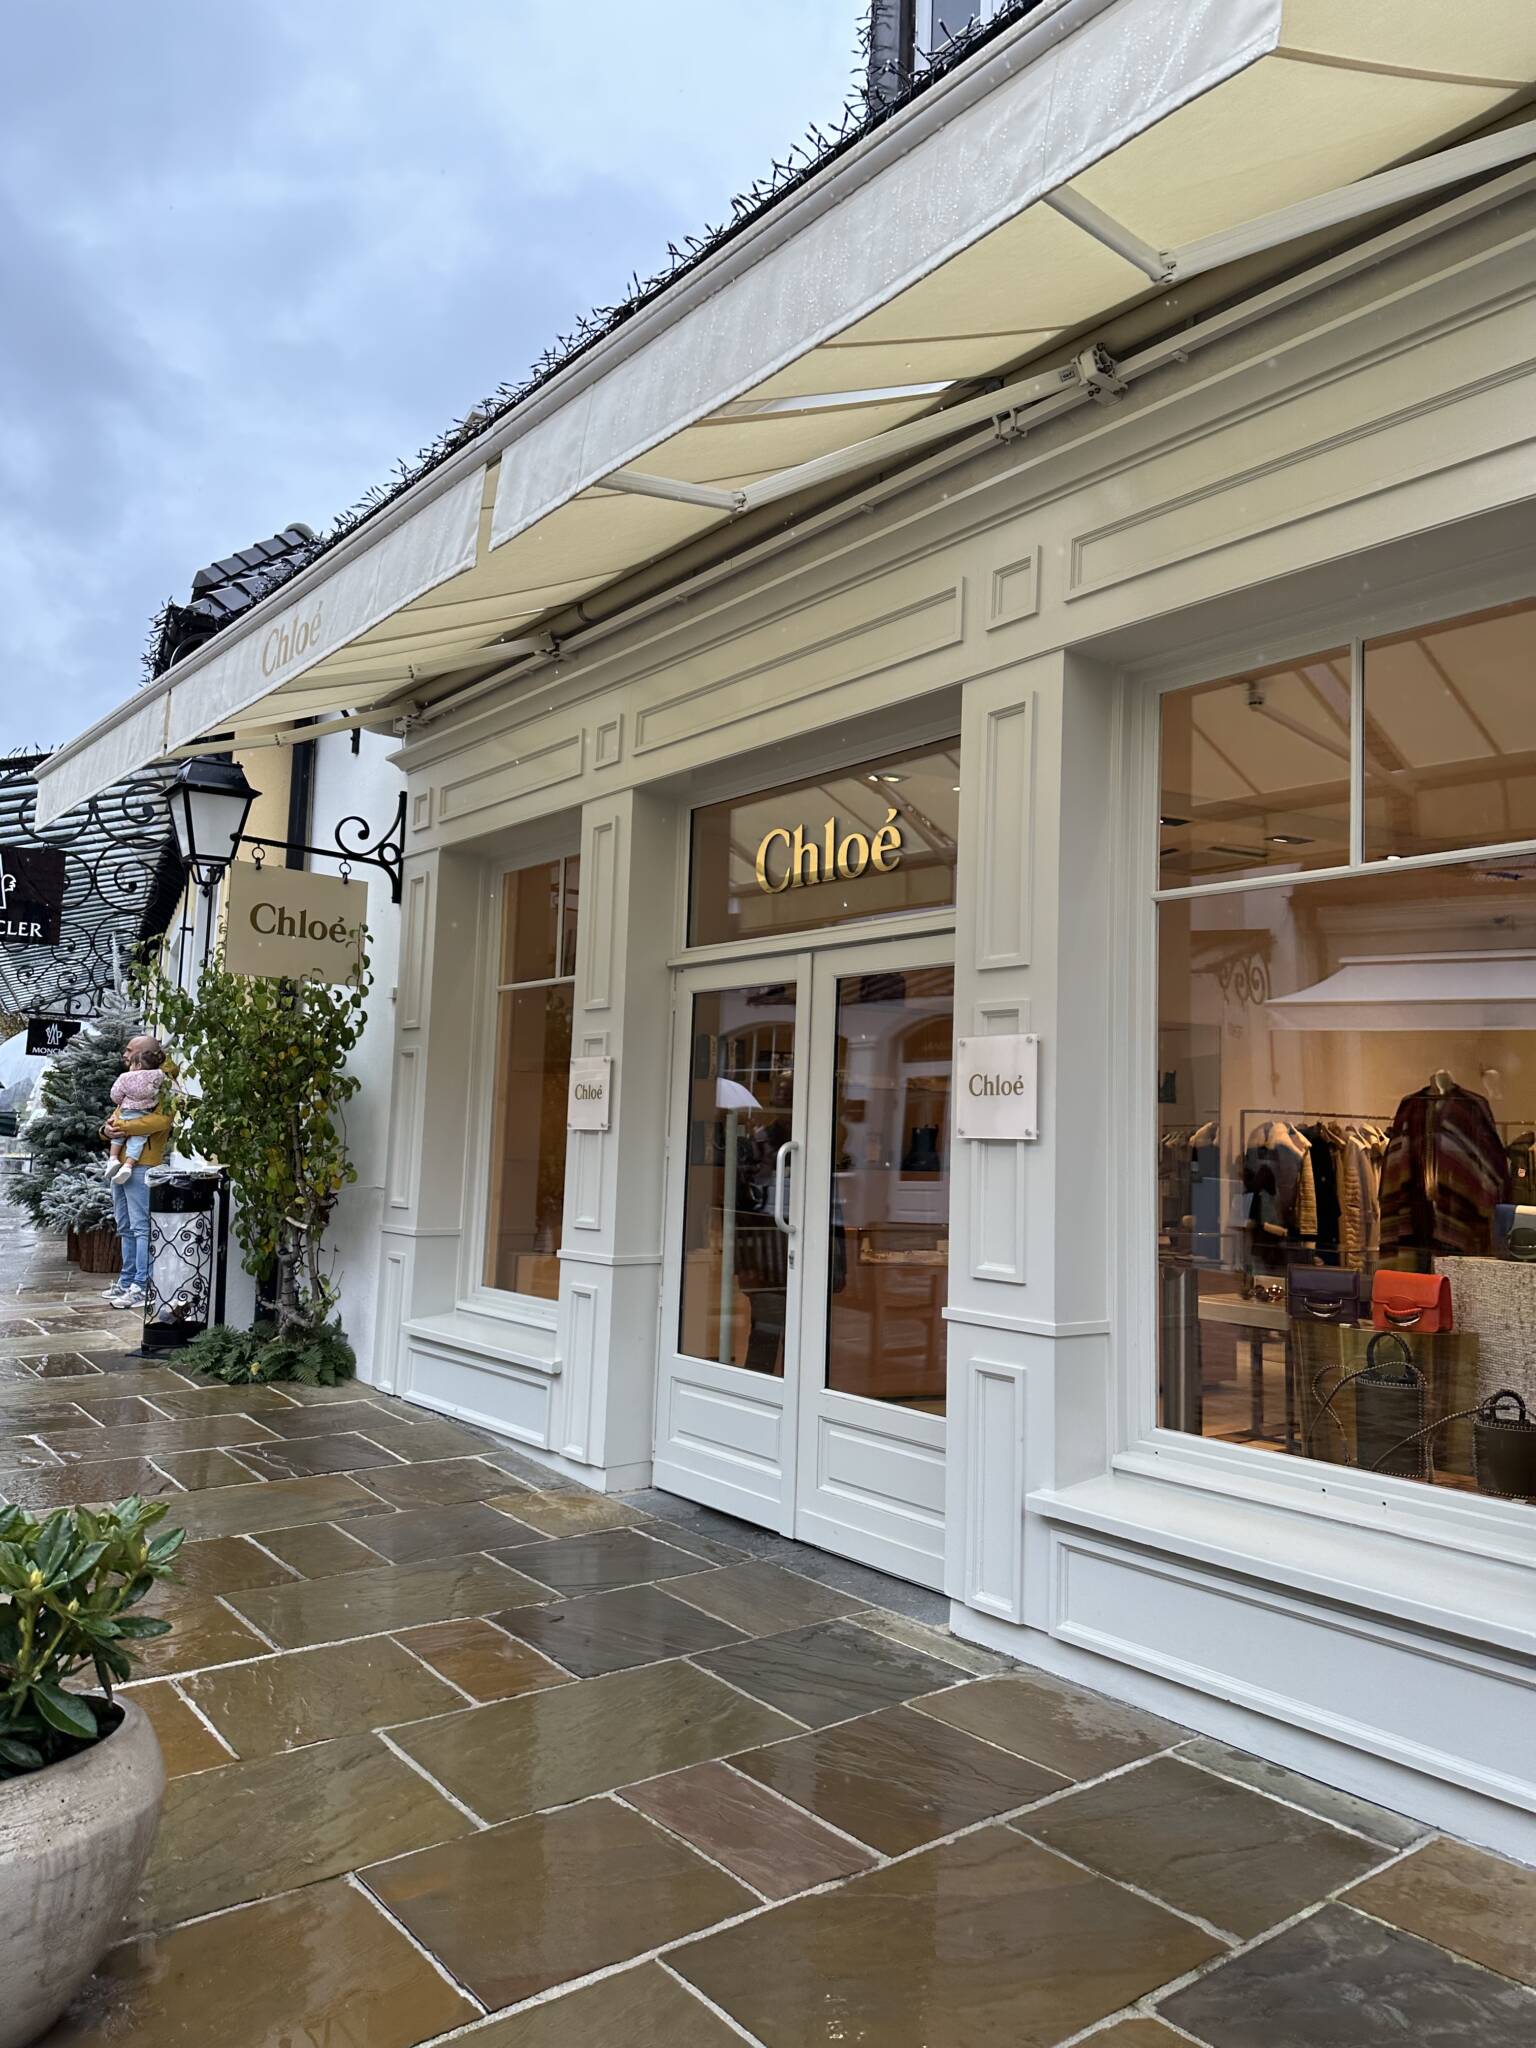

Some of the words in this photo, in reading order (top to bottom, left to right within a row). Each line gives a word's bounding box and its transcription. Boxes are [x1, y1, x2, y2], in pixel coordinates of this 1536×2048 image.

[262, 600, 323, 677] Chloé
[755, 807, 902, 894] Chloé
[249, 902, 347, 943] Chloé
[574, 1083, 603, 1101] Chloé
[968, 1073, 1025, 1097] Chloé
